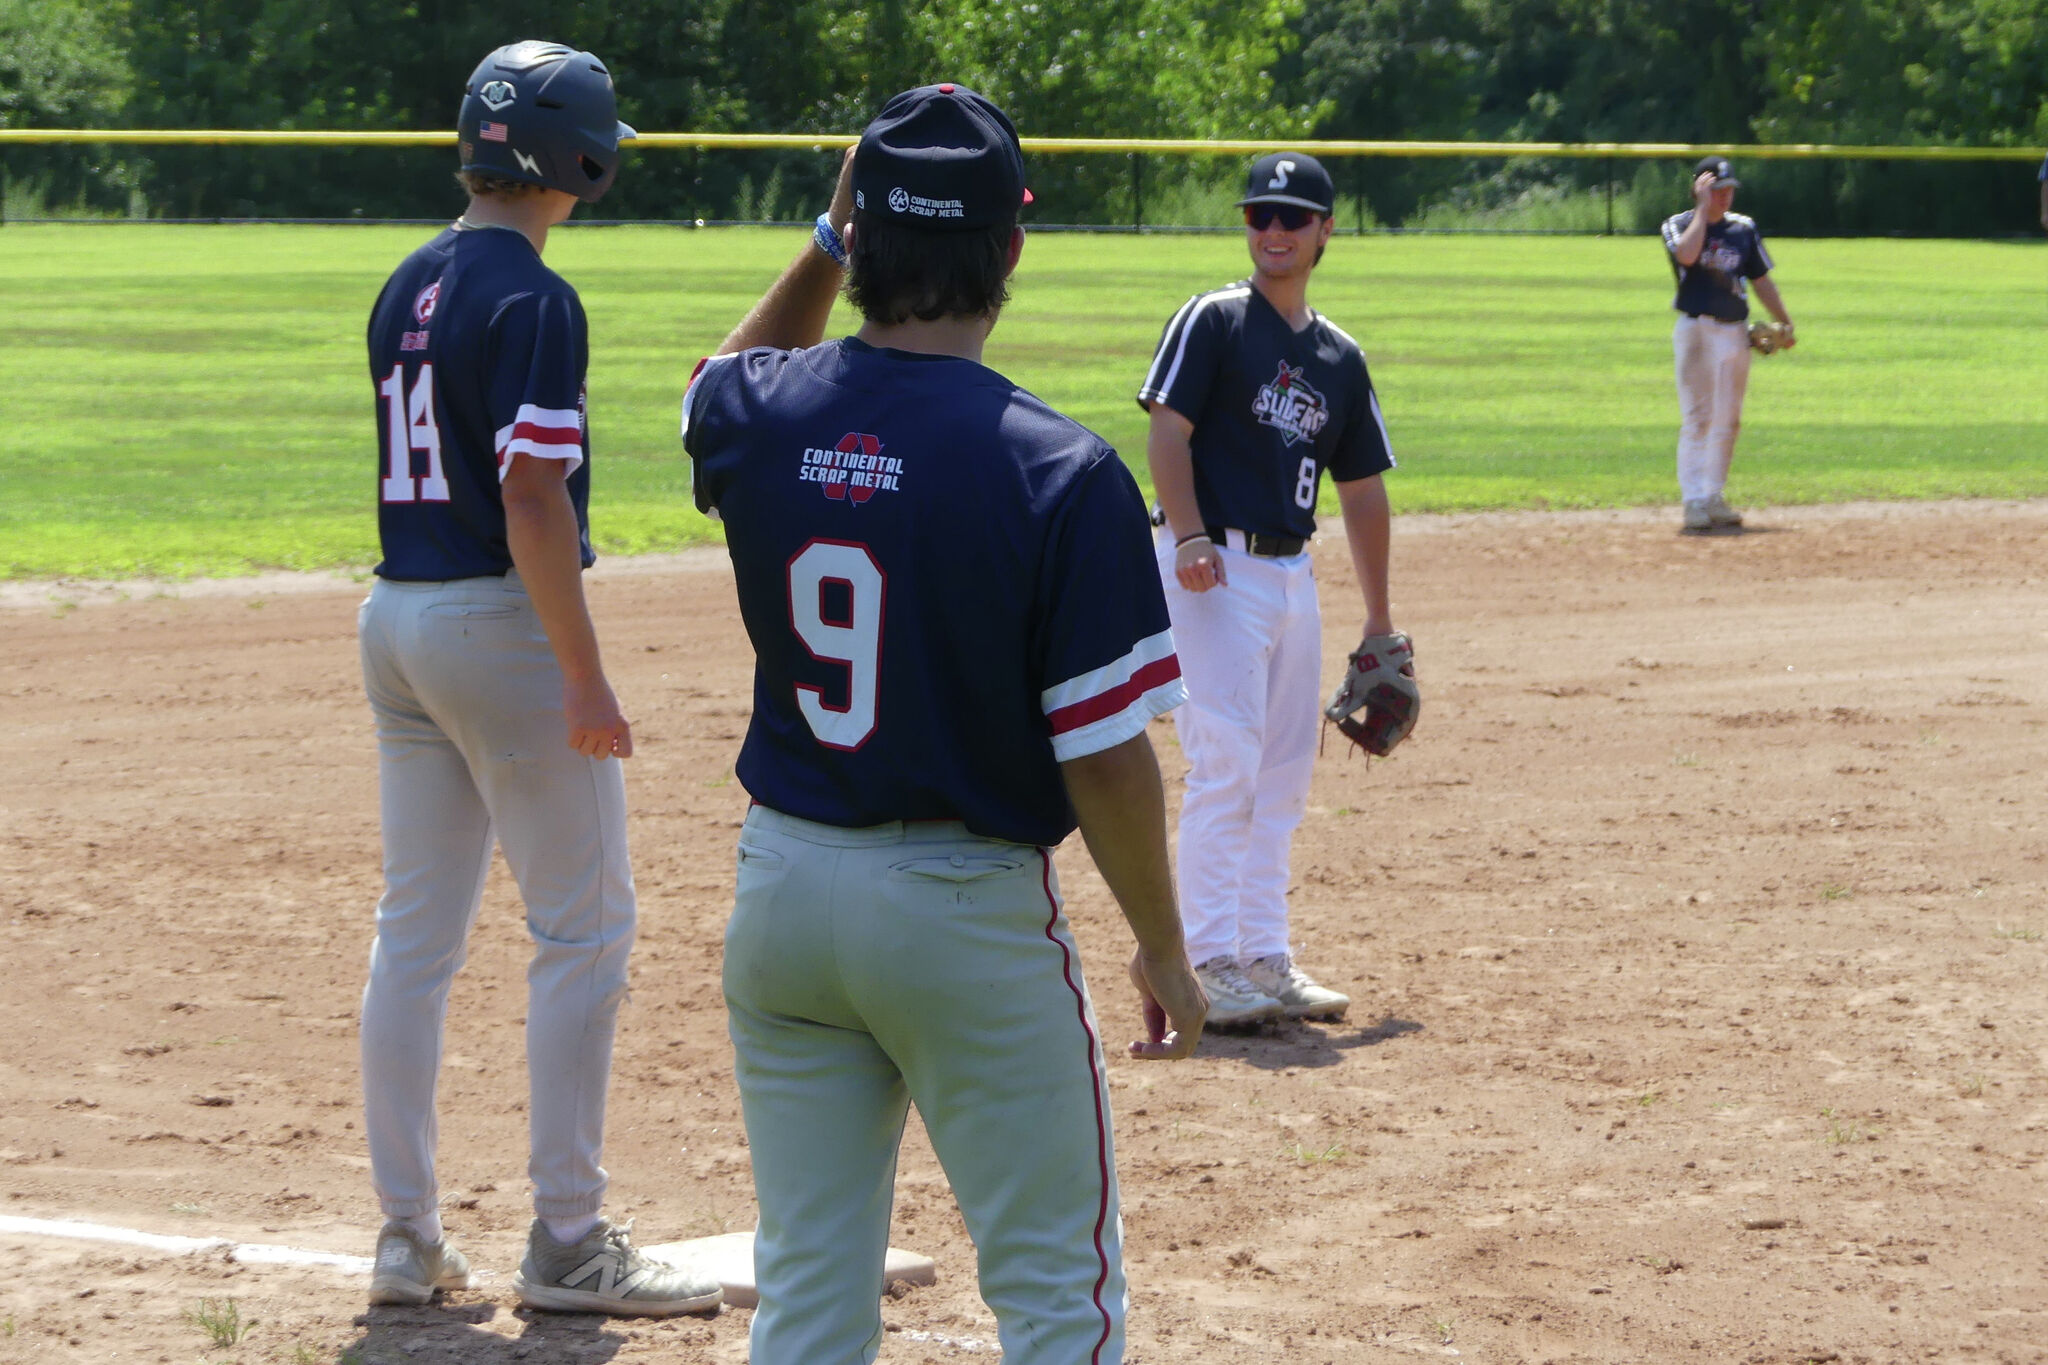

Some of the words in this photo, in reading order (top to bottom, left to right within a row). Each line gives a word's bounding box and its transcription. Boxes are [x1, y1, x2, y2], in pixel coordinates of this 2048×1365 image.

[1268, 160, 1296, 189] S
[909, 205, 936, 217] SCRAP
[938, 208, 964, 217] METAL
[910, 195, 964, 209] CONTINENTAL
[379, 361, 451, 503] 14
[802, 447, 904, 475] CONTINENTAL
[799, 465, 848, 484] SCRAP
[850, 470, 900, 492] METAL
[1295, 456, 1316, 510] 8
[786, 536, 887, 752] 9
